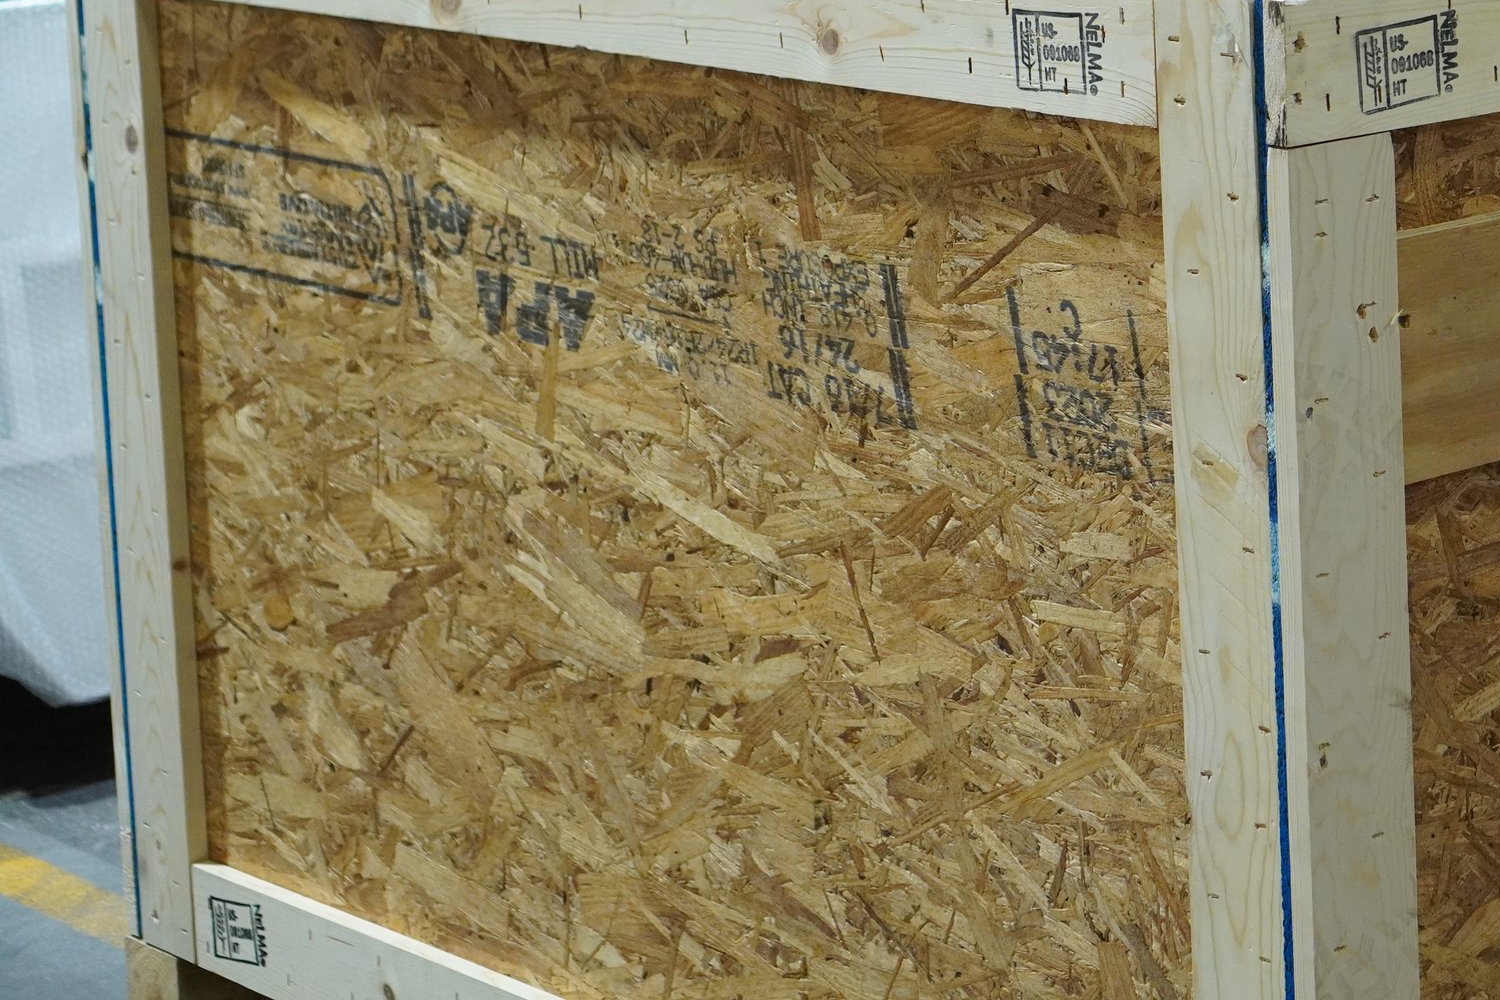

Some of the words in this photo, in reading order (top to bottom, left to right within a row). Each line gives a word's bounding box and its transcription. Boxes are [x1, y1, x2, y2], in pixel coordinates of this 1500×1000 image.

[1085, 12, 1104, 85] NELMA
[1044, 66, 1057, 82] HT
[1393, 78, 1408, 97] HT
[475, 268, 597, 353] APA
[1060, 299, 1082, 342] C
[778, 323, 861, 374] 24/16
[767, 360, 814, 405] CAT
